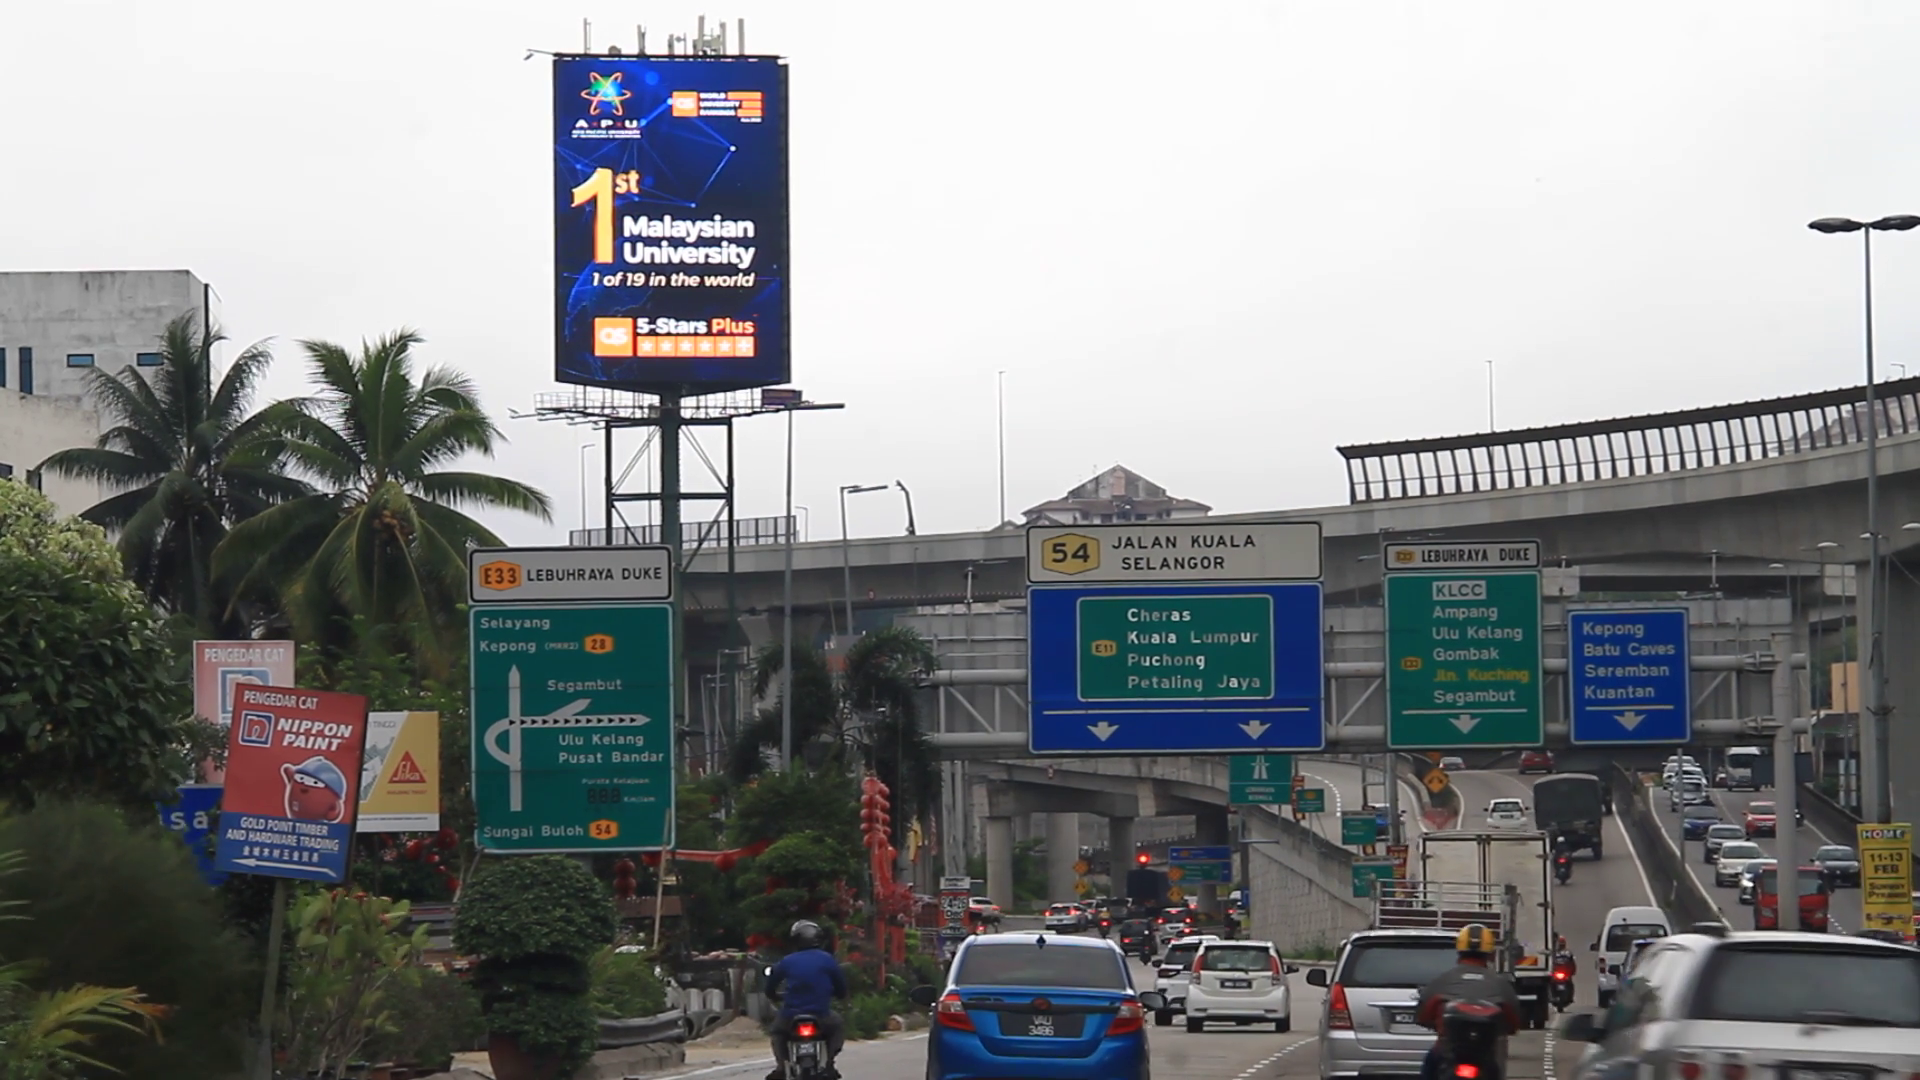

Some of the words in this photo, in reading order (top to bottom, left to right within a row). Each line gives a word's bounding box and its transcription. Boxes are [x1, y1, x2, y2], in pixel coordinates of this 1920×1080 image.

[623, 215, 755, 243] Malaysian
[623, 240, 756, 269] University
[592, 273, 600, 286] 1
[603, 273, 624, 286] of
[626, 273, 645, 286] 19
[649, 273, 666, 286] in
[670, 273, 700, 286] the
[704, 273, 755, 287] world
[636, 317, 708, 334] 5-Stars
[711, 318, 755, 334] Plus
[599, 328, 629, 346] QS
[1111, 535, 1178, 550] JALAN
[1191, 534, 1257, 549] KUALA
[1051, 542, 1091, 564] 54
[1421, 549, 1489, 563] LEBUHRAYA
[1499, 548, 1530, 562] DUKE
[1121, 556, 1225, 571] SELANGOR
[484, 568, 518, 585] E33
[527, 568, 615, 582] LEBUHRAYA
[621, 567, 663, 581] DUKE
[1435, 583, 1484, 598] KLCC
[1127, 608, 1191, 622] Cheras
[1432, 606, 1498, 621] Ampang
[480, 617, 550, 630] Selayang
[1582, 622, 1644, 638] Kepong
[1127, 630, 1178, 645] Kuala
[1190, 630, 1259, 647] Lumpur
[1432, 627, 1459, 640] Ulu
[1467, 627, 1523, 641] Kelang
[479, 640, 536, 653] Kepong
[590, 638, 606, 650] 28
[1094, 643, 1114, 653] E11
[1583, 643, 1620, 657] Batu
[1628, 642, 1676, 656] Caves
[204, 648, 262, 663] PENGEDAR
[265, 648, 284, 662] CAT
[1127, 653, 1206, 670] Puchong
[1433, 648, 1499, 661] Gombak
[1468, 668, 1529, 683] Kuching
[1585, 664, 1670, 678] Seremban
[547, 679, 622, 692] Segambut
[1127, 675, 1204, 692] Petaling
[1217, 675, 1261, 691] Jaya
[1433, 689, 1516, 706] Segambut
[1584, 685, 1655, 699] Kuantan
[243, 690, 297, 708] PENGEDAR
[298, 697, 319, 710] CAT
[277, 718, 352, 738] NIPPON
[282, 733, 342, 751] PAINT
[558, 734, 584, 746] Ulu
[592, 733, 644, 747] Kelang
[558, 752, 602, 764] Pusat
[611, 751, 664, 763] Bandar
[240, 816, 266, 830] GOLD
[267, 819, 293, 833] POINT
[295, 822, 328, 836] TIMBER
[483, 825, 533, 840] Sungai
[541, 825, 584, 837] Buloh
[595, 824, 611, 836] 54
[226, 828, 246, 840] AND
[248, 830, 298, 846] HARDWARE
[300, 836, 339, 851] TRADING
[1874, 864, 1899, 874] FEB
